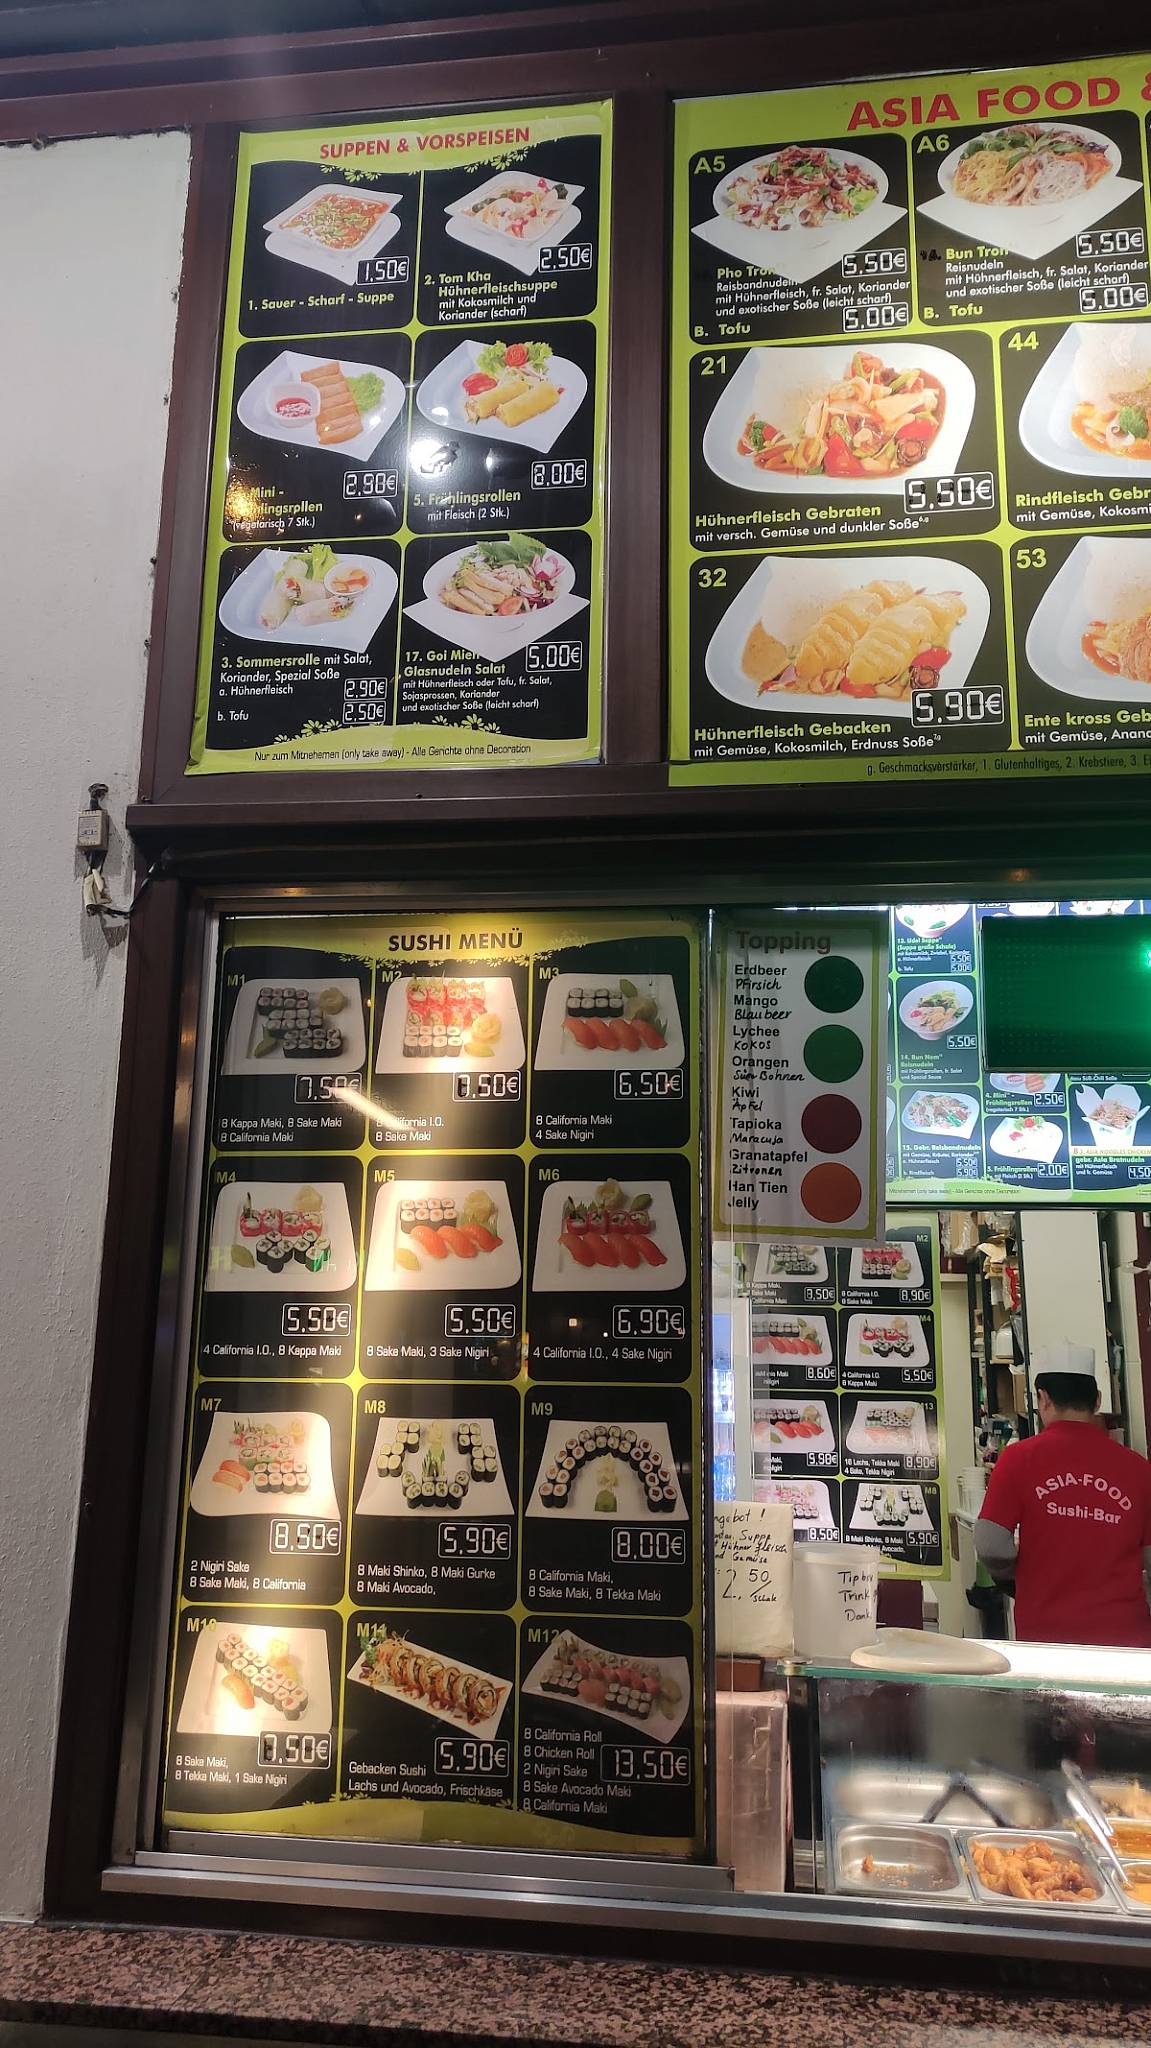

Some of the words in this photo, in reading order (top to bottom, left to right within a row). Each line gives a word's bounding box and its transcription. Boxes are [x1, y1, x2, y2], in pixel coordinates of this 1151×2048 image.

[847, 94, 960, 131] ASIA
[977, 77, 1120, 118] FOOD
[320, 139, 390, 159] SUPPEN
[397, 138, 408, 152] &
[416, 127, 530, 150] VORSPEISEN
[917, 134, 950, 154] A6
[694, 156, 726, 174] A5
[1078, 231, 1142, 255] 5.50€
[541, 247, 590, 269] 2.50€
[946, 248, 973, 259] Bun
[844, 252, 905, 275] 5.50€
[946, 260, 1003, 273] Reisnudeln
[1095, 261, 1149, 273] Koriander
[365, 260, 407, 282] 1.50€
[439, 274, 463, 284] Tom
[467, 271, 491, 282] Kha
[718, 268, 742, 279] Pho
[438, 281, 558, 297] Hühnerfleischsuppe
[735, 288, 809, 303] Hühnerfleisch,
[826, 285, 854, 296] Salat,
[859, 281, 910, 293] Koriander
[262, 299, 295, 309] Sauer
[308, 293, 345, 306] Scharf
[357, 292, 394, 306] Suppe
[458, 294, 513, 308] Kokosmilch
[518, 293, 536, 303] und
[1082, 288, 1146, 310] 5.00€
[439, 310, 487, 321] Koriander
[491, 305, 527, 318] (scharf)
[739, 302, 789, 315] exotischer
[949, 303, 983, 317] Tofu
[846, 306, 907, 329] 5.00€
[719, 323, 750, 336] Tofu
[1008, 331, 1039, 351] 44
[701, 356, 726, 375] 21
[909, 477, 992, 510] 5.50€
[1016, 489, 1104, 507] Rindfleisch
[445, 509, 475, 519] Fleisch
[695, 509, 801, 528] Hühnerfleisch
[806, 505, 881, 520] Gebraten
[1017, 511, 1036, 522] mit
[1040, 509, 1095, 520] Gemüse,
[695, 532, 714, 542] mit
[717, 528, 757, 541] versch.
[761, 525, 809, 538] Gemüse
[814, 523, 836, 535] und
[840, 520, 885, 533] dunkler
[1017, 548, 1046, 568] 53
[699, 568, 727, 588] 32
[237, 653, 321, 668] Sommersrolle
[324, 653, 340, 665] mit
[344, 653, 372, 665] Salat,
[405, 651, 422, 662] 17.
[427, 650, 447, 661] Goi
[529, 644, 580, 669] 5.00€
[220, 671, 272, 683] Koriander,
[275, 669, 311, 682] Spezial
[314, 668, 340, 680] Soße
[404, 665, 472, 678] Glasnudeln
[475, 663, 506, 675] Salat
[231, 684, 293, 696] Hühnerfleisch
[346, 680, 384, 699] 2.90€
[403, 691, 457, 700] Sojasprossen,
[460, 690, 500, 699] Koriander
[345, 704, 384, 722] 2.50€
[420, 701, 460, 711] exotischer
[916, 691, 1001, 723] 5.90€
[229, 710, 248, 721] Tofu
[1025, 714, 1061, 727] Ente
[1066, 711, 1111, 725] kross
[695, 721, 804, 741] Hühnerfleisch
[809, 721, 891, 736] Gebacken
[1025, 732, 1046, 743] mit
[1050, 730, 1107, 742] Gemüse,
[487, 744, 531, 754] Decoration
[717, 744, 770, 757] Gemüse,
[775, 740, 847, 754] Kokosmilch,
[851, 739, 899, 750] Erdnuss
[389, 934, 451, 951] SUSHI
[459, 928, 523, 949] MENÜ
[737, 931, 831, 954] Topping
[539, 968, 560, 979] M3
[735, 965, 787, 975] Erdbeer
[734, 995, 778, 1008] Mango
[733, 1025, 780, 1038] Lychee
[733, 1056, 789, 1069] Orangen
[732, 1087, 759, 1098] Kiwi
[231, 1118, 259, 1130] Kappa
[546, 1115, 588, 1126] California
[731, 1118, 782, 1131] Tapioka
[230, 1132, 269, 1142] California
[571, 1129, 594, 1141] Nigiri
[730, 1133, 783, 1145] Maracuja
[730, 1149, 807, 1163] Granatapfel
[216, 1171, 236, 1182] M4
[374, 1170, 395, 1182] M5
[539, 1169, 560, 1181] M6
[729, 1181, 754, 1192] Han
[759, 1181, 788, 1193] Tien
[728, 1197, 759, 1211] Jelly
[287, 1307, 348, 1332] 5.50€
[450, 1308, 513, 1334] 5.50€
[618, 1309, 682, 1335] 6.90€
[213, 1346, 254, 1355] California
[288, 1346, 316, 1358] Kappa
[543, 1349, 586, 1359] California
[648, 1349, 672, 1361] Nigiri
[201, 1398, 222, 1410] M7
[364, 1401, 386, 1413] M8
[531, 1403, 553, 1416] M9
[1035, 1472, 1132, 1511] ASIA-FOOD
[1047, 1502, 1121, 1524] Sushi-Bar
[444, 1527, 508, 1555] 5.90€
[617, 1532, 682, 1559] 8.00€
[200, 1561, 225, 1573] Nigiri
[393, 1566, 428, 1578] Shinko,
[467, 1568, 495, 1579] Gurke
[539, 1570, 584, 1582] California
[393, 1582, 436, 1594] Avocado,
[539, 1587, 562, 1598] Sake
[606, 1589, 634, 1600] Tekka
[535, 1728, 581, 1742] California
[584, 1731, 602, 1742] Roll
[440, 1742, 507, 1772] 5.90€
[535, 1747, 573, 1759] Chicken
[576, 1748, 595, 1759] Roll
[349, 1762, 396, 1775] Gebacken
[400, 1765, 426, 1777] Sushi
[534, 1764, 561, 1777] Nigiri
[614, 1750, 688, 1779] 13.50€
[184, 1771, 207, 1782] Tekka
[266, 1774, 287, 1786] Nigiri
[349, 1779, 378, 1791] Lachs
[381, 1781, 398, 1793] und
[450, 1784, 503, 1797] Frischkäse
[561, 1783, 603, 1796] Avocado
[533, 1800, 580, 1813] California
